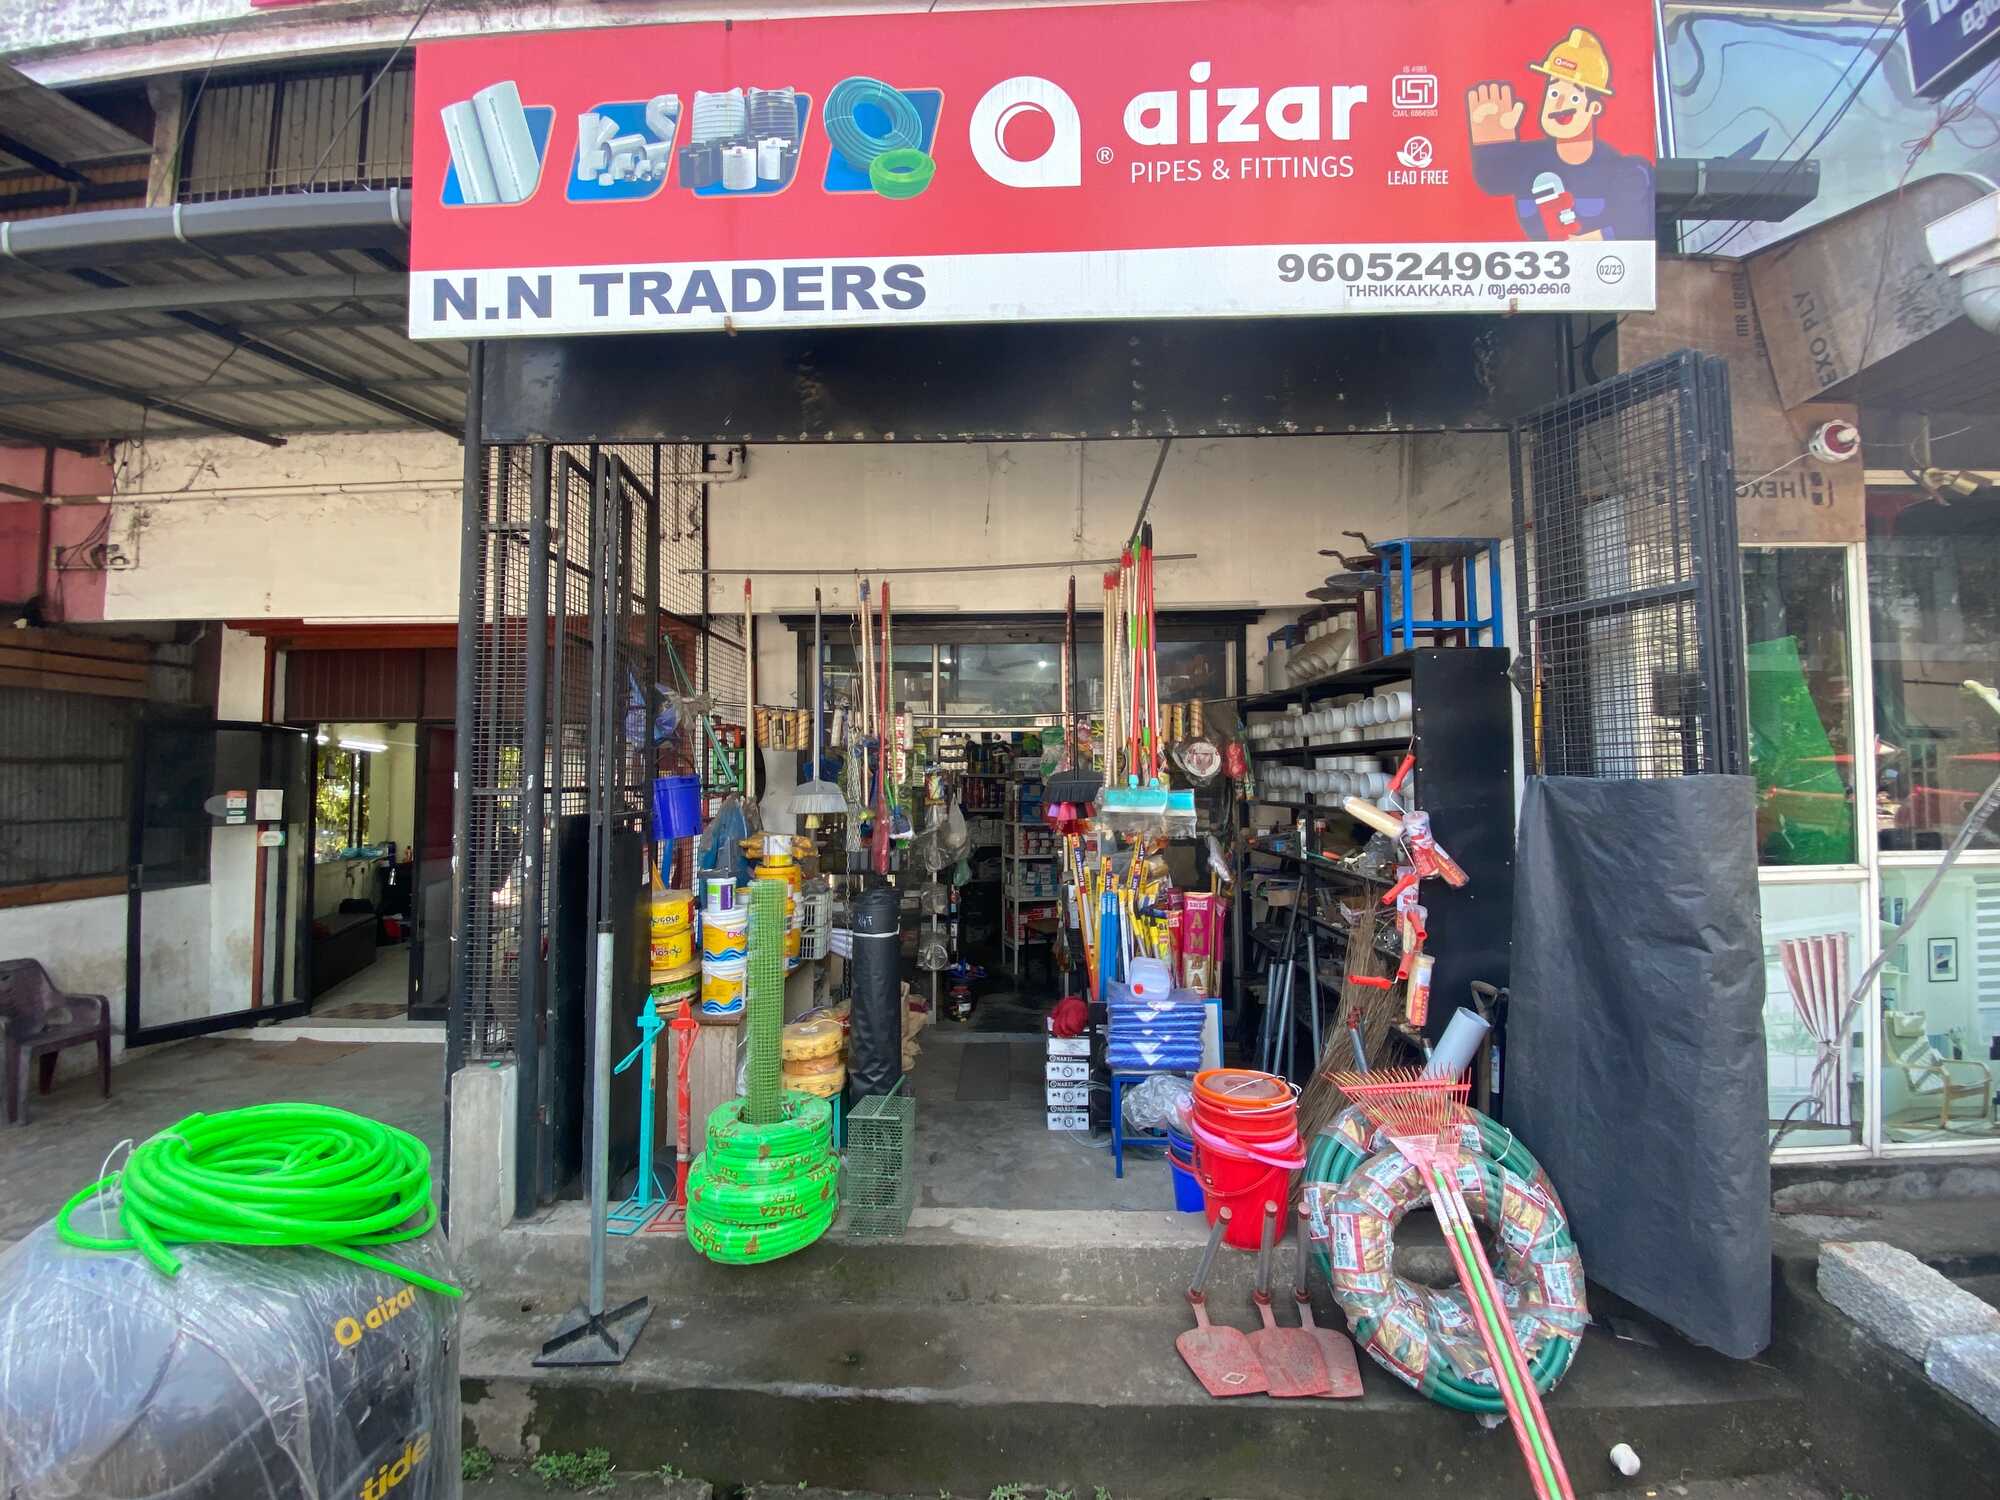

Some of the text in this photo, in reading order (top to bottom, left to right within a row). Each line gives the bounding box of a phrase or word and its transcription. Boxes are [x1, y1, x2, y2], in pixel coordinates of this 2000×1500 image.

[1123, 61, 1368, 146] aizar
[1131, 155, 1354, 184] PIPES & FITTINGS
[1387, 169, 1449, 185] LEAD FREE
[1277, 250, 1571, 282] 9605249633
[1598, 264, 1623, 277] 02/23
[432, 263, 926, 322] N.N TRADERS
[1346, 284, 1475, 298] THRIKKAKKARA
[760, 1204, 804, 1218] PLAZA
